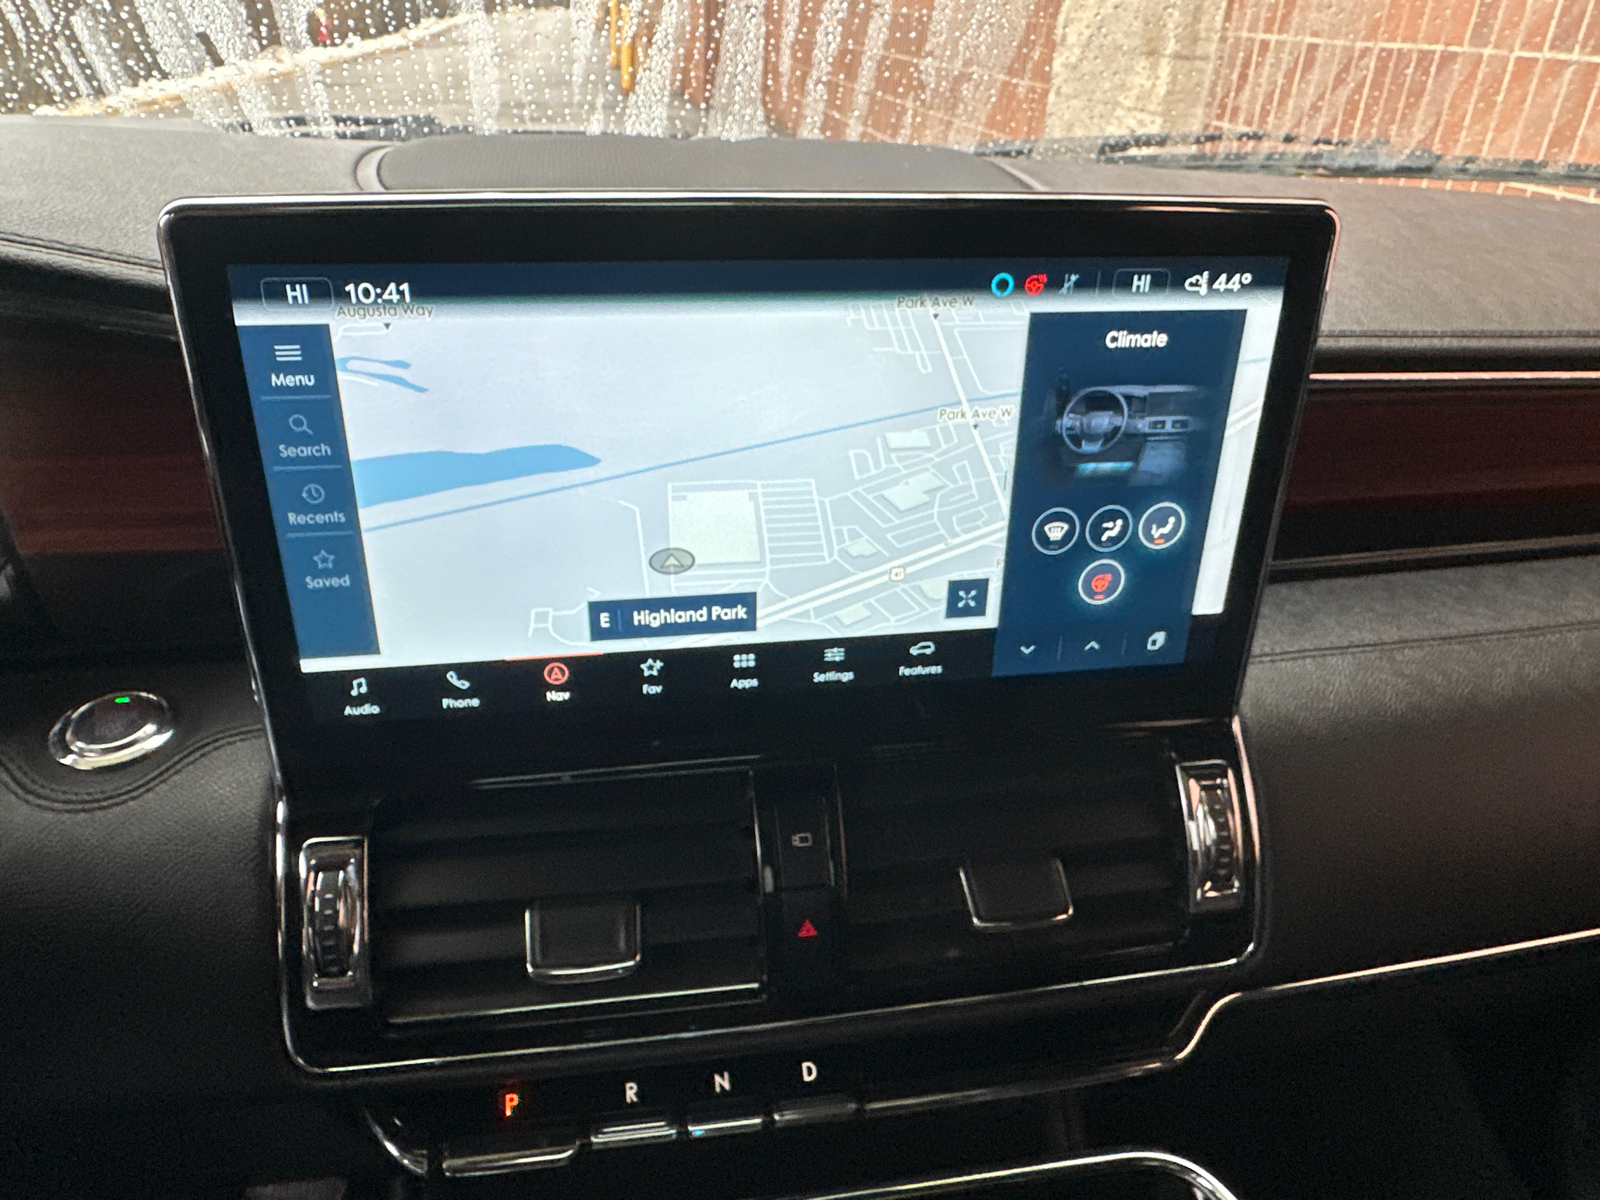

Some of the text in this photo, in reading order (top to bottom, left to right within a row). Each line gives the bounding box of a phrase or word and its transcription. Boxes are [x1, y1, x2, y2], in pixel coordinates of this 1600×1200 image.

[1131, 274, 1151, 293] HI
[286, 283, 309, 305] HI
[344, 281, 412, 304] 10:41
[897, 295, 975, 308] Park Ave W
[337, 304, 434, 320] Augusta Way
[1105, 329, 1169, 351] Climate
[270, 373, 315, 388] Menu
[938, 407, 1013, 423] Park Ave W
[278, 442, 332, 459] Search
[287, 511, 346, 526] Recents
[305, 574, 351, 589] Saved
[599, 604, 748, 628] E Highland Park
[812, 669, 855, 685] Settings
[899, 663, 943, 677] Features
[642, 684, 664, 696] Fav
[729, 676, 759, 690] Apps
[442, 697, 480, 710] Phone
[546, 690, 571, 702] Nav
[343, 703, 381, 717] Audio
[801, 1061, 818, 1082] D
[714, 1071, 731, 1093] N
[625, 1082, 638, 1103] R
[504, 1093, 519, 1117] P
